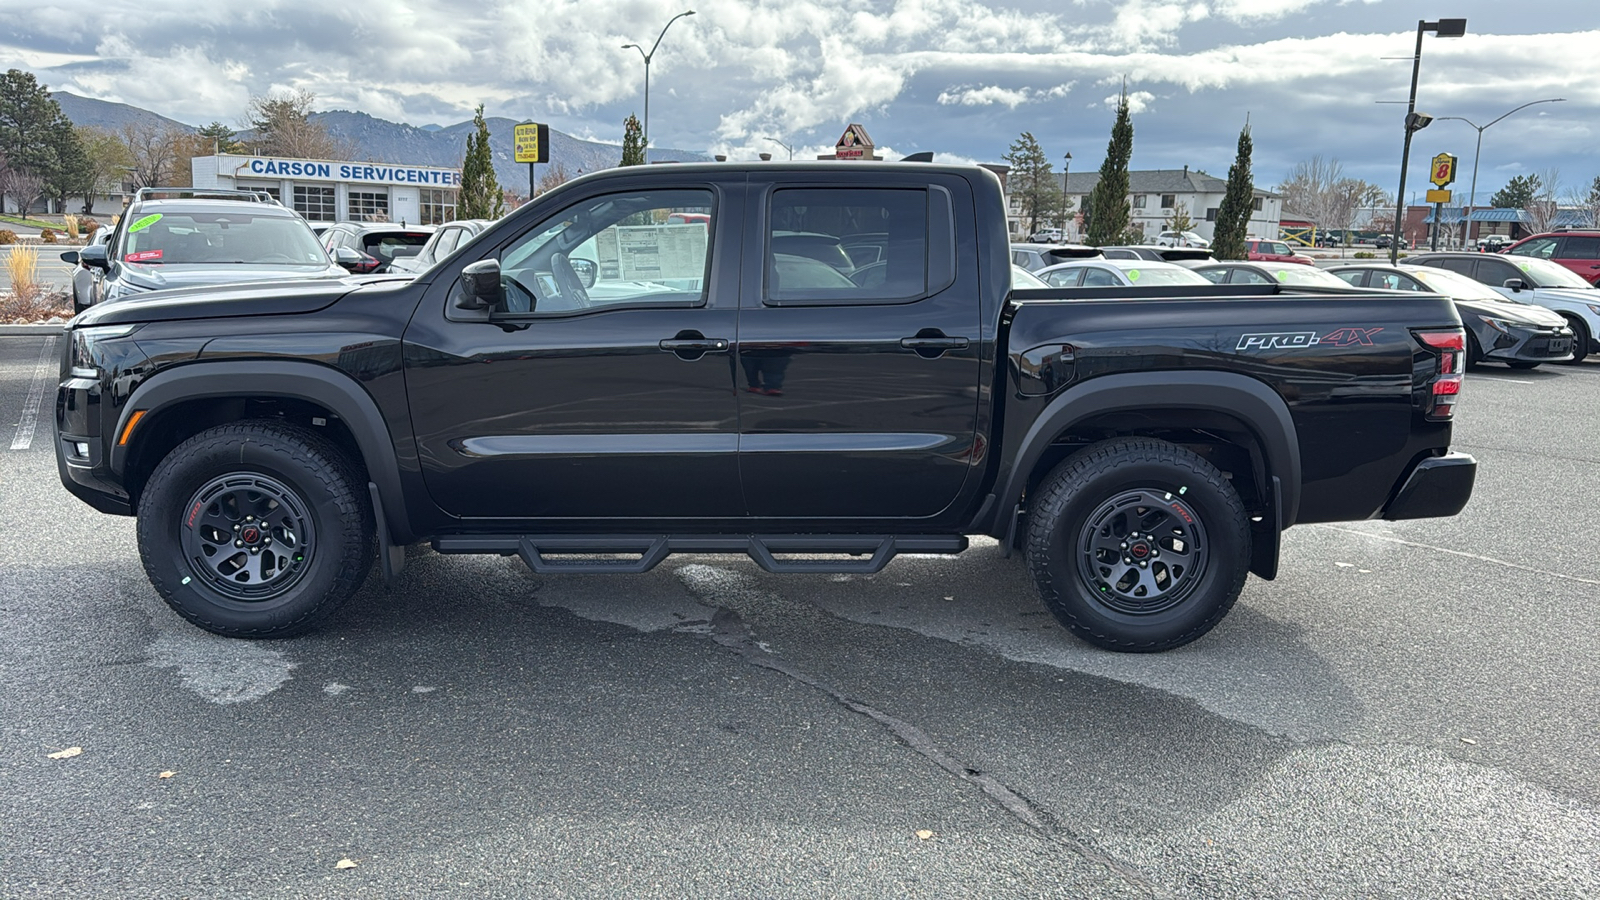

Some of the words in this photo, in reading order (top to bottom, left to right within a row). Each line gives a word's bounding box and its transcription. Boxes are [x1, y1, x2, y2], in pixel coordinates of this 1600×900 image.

[251, 160, 330, 177] CARSON
[340, 165, 462, 185] SERVICENTER
[1436, 163, 1450, 179] 8
[188, 502, 200, 526] PRO
[1172, 504, 1192, 523] PRO
